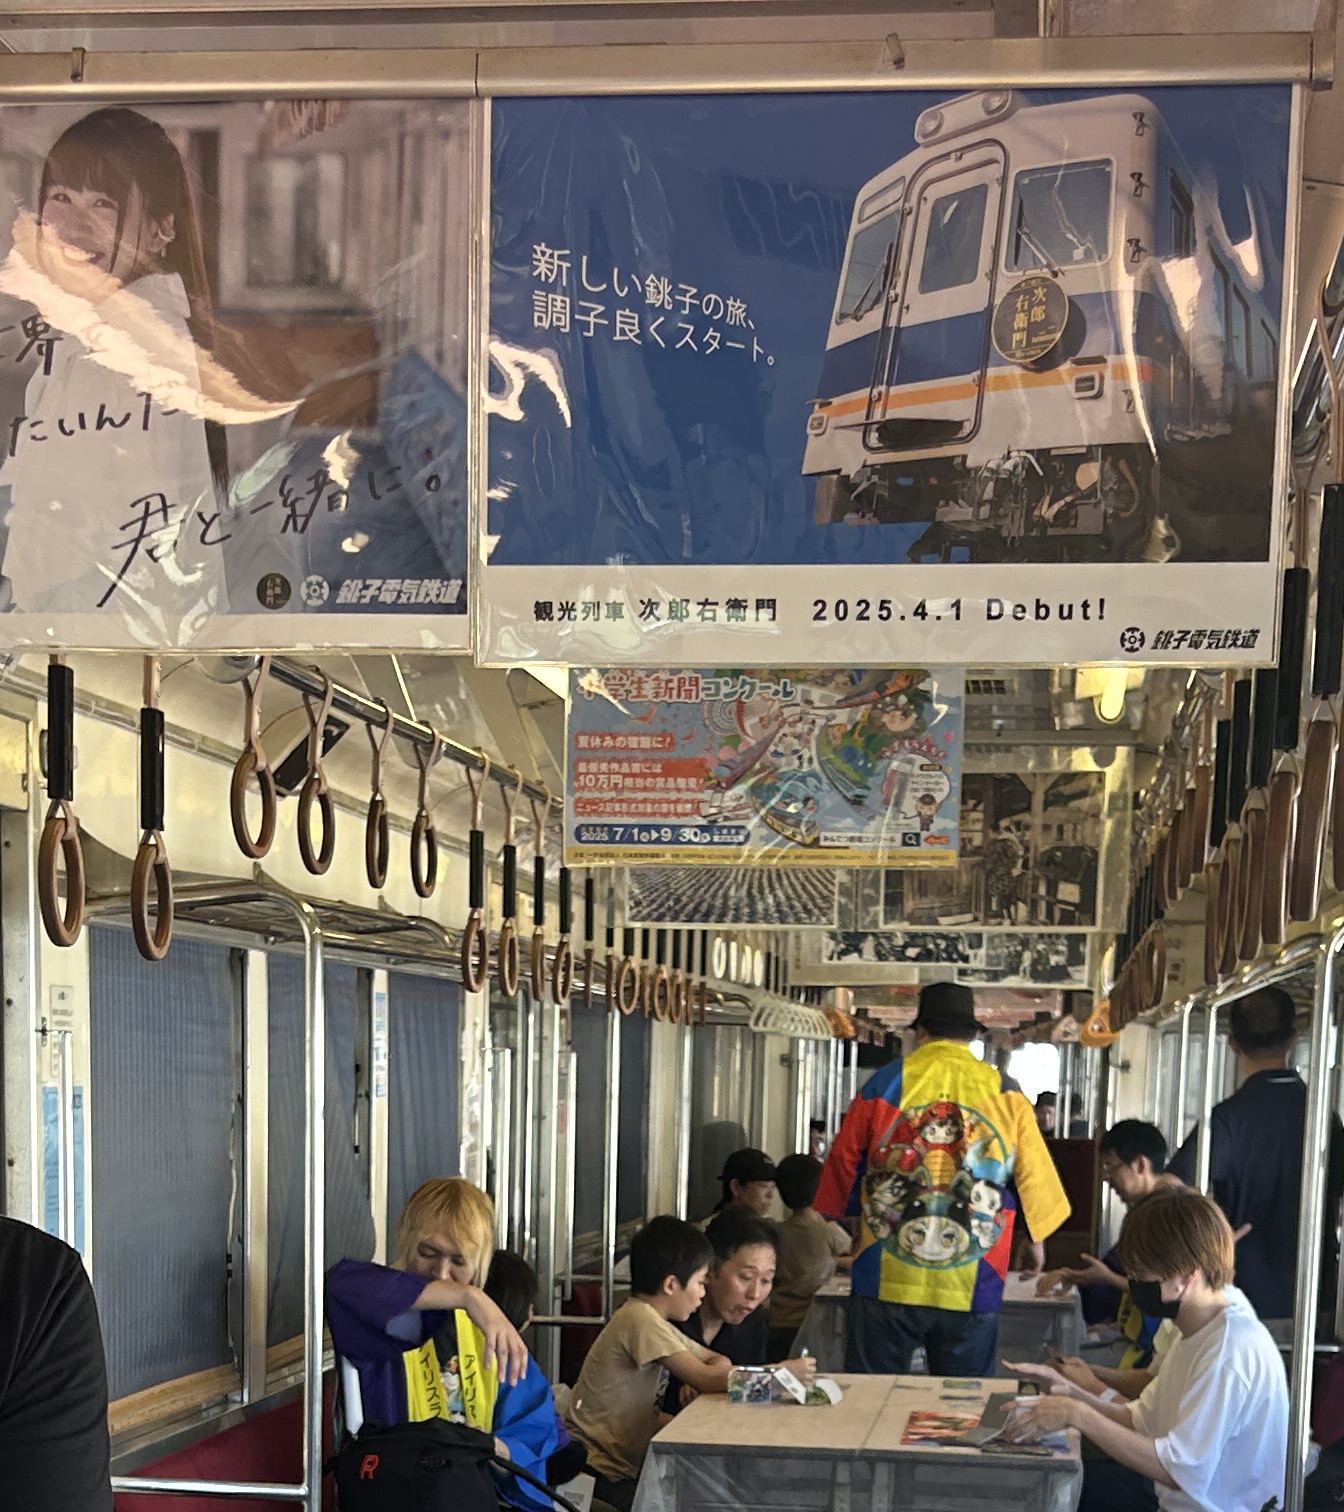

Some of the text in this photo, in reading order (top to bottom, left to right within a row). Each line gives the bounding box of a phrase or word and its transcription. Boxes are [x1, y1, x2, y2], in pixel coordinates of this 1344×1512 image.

[531, 241, 756, 330] 新しい銚子の旅、
[531, 290, 775, 366] 調子良くスタート。
[96, 465, 442, 608] 君と一緒に。
[336, 578, 463, 605] 銚子電気鉄道
[533, 597, 1107, 623] 観光列車 次郎右衛門 2025.4.1 Debut!
[1150, 627, 1260, 651] 銚子電気鉄道
